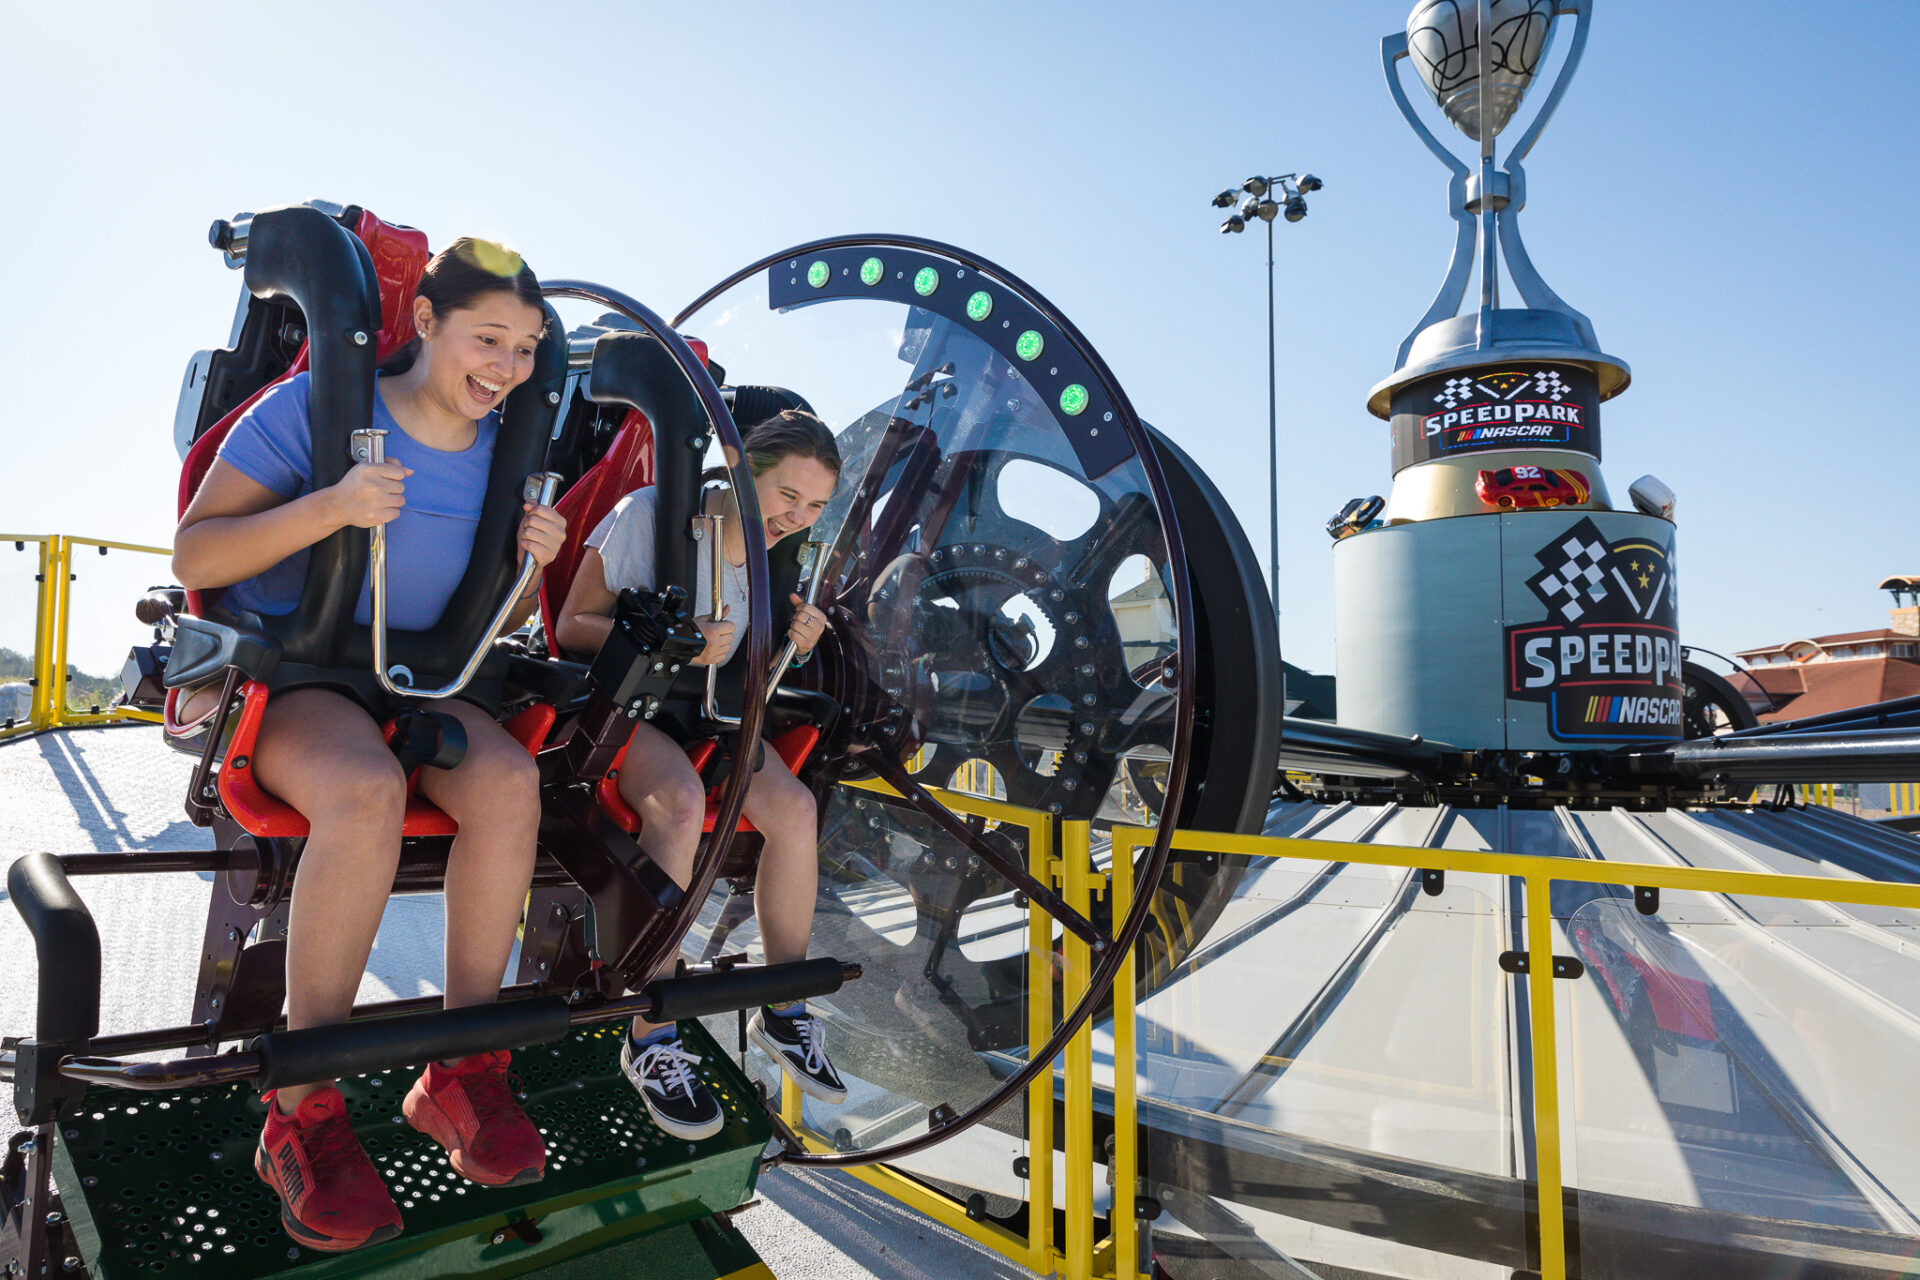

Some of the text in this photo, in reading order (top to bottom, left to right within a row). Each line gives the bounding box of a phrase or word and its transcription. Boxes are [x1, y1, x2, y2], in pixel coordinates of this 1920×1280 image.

[1426, 404, 1580, 437] SPEEDPARK
[1480, 425, 1554, 438] NASCAR
[1514, 466, 1541, 479] 92
[1524, 634, 1682, 688] SPEEDPA
[278, 1140, 304, 1206] PUMA
